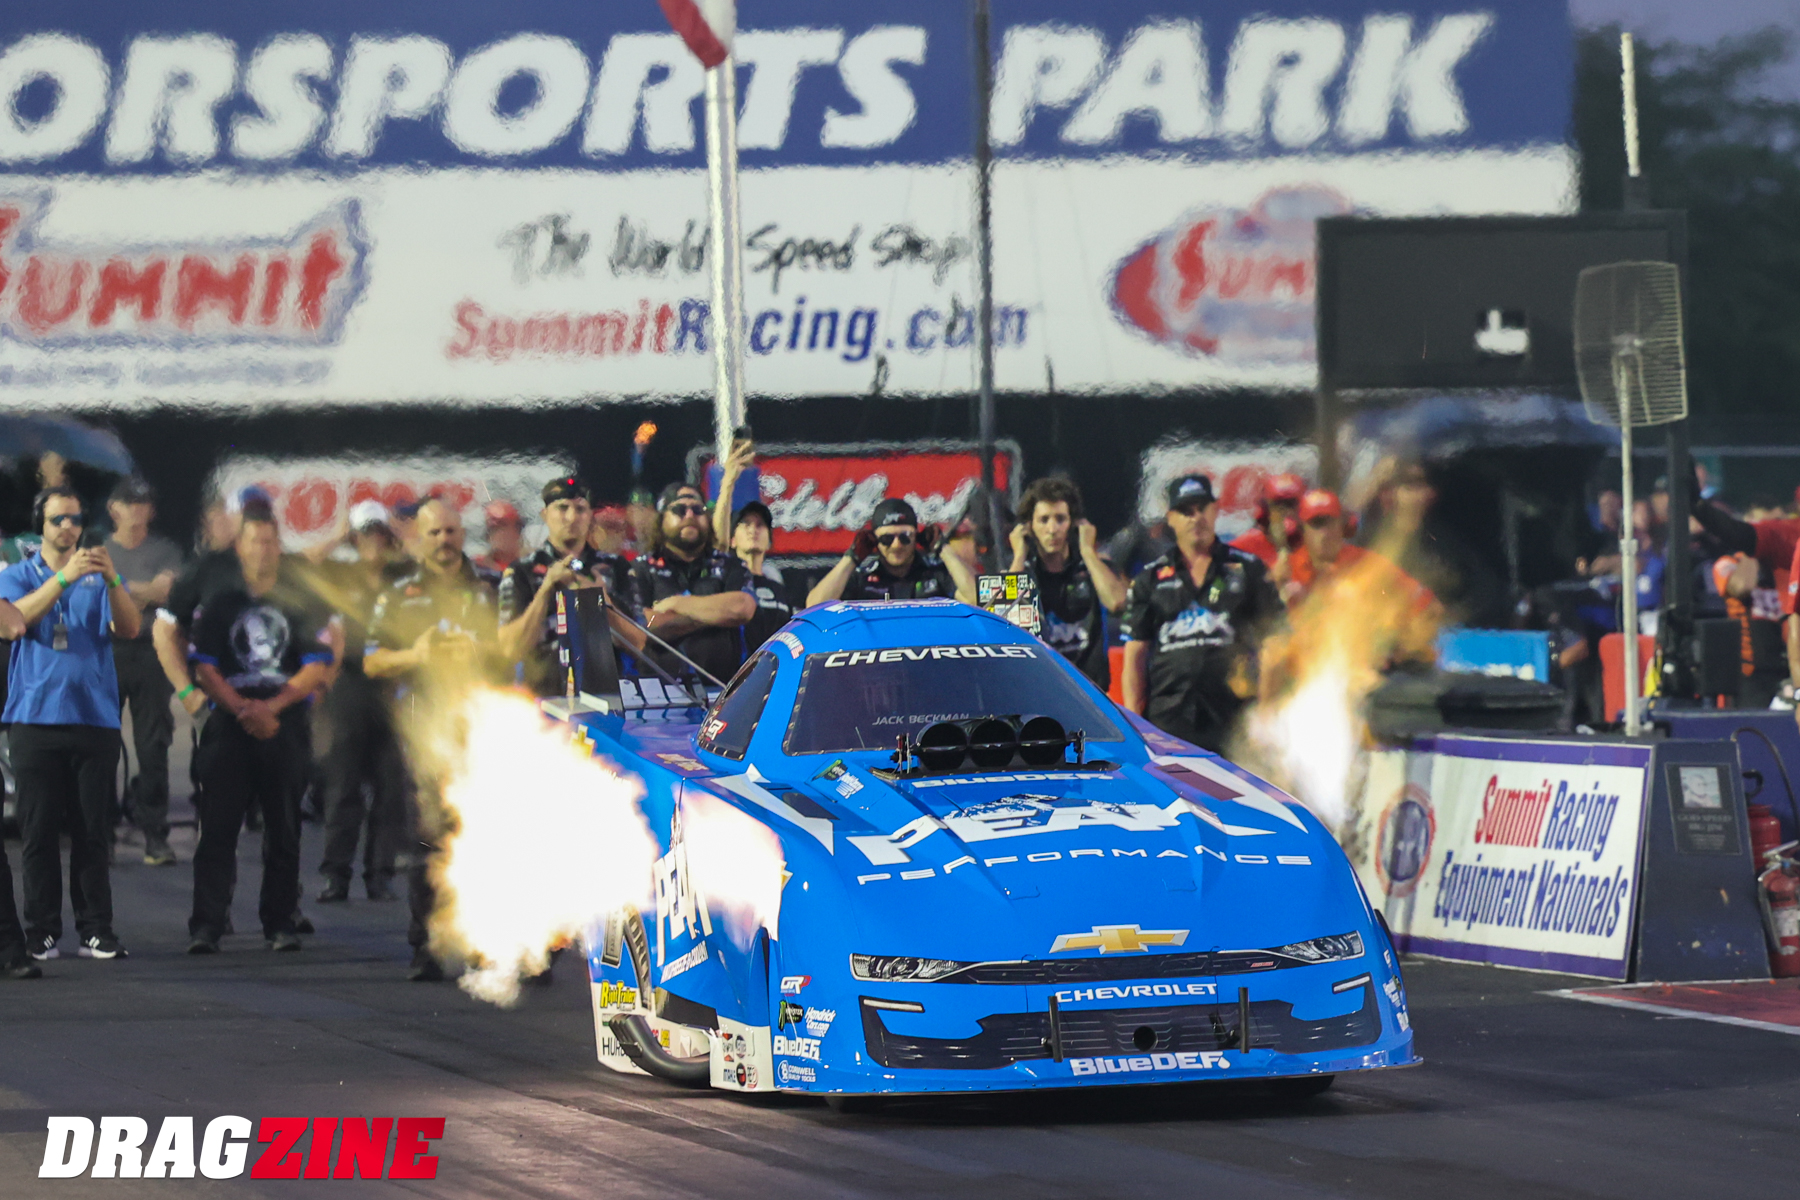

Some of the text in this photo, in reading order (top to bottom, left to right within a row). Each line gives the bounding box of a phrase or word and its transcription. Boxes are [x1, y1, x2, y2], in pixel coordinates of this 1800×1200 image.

[988, 14, 1495, 147] PARK
[746, 221, 864, 293] Speed
[445, 296, 1029, 362] SummitRcing.com
[824, 645, 1037, 668] CHEVROLET
[872, 713, 969, 726] JACK BECKMAN
[846, 797, 1278, 866] PEAK
[1474, 774, 1620, 862] Summit Racing
[856, 845, 1312, 885] PERFORMANCE
[1433, 850, 1628, 938] Equipment Nationals
[1055, 983, 1218, 1003] CHEVROLET
[1070, 1051, 1224, 1076] BlueDEF
